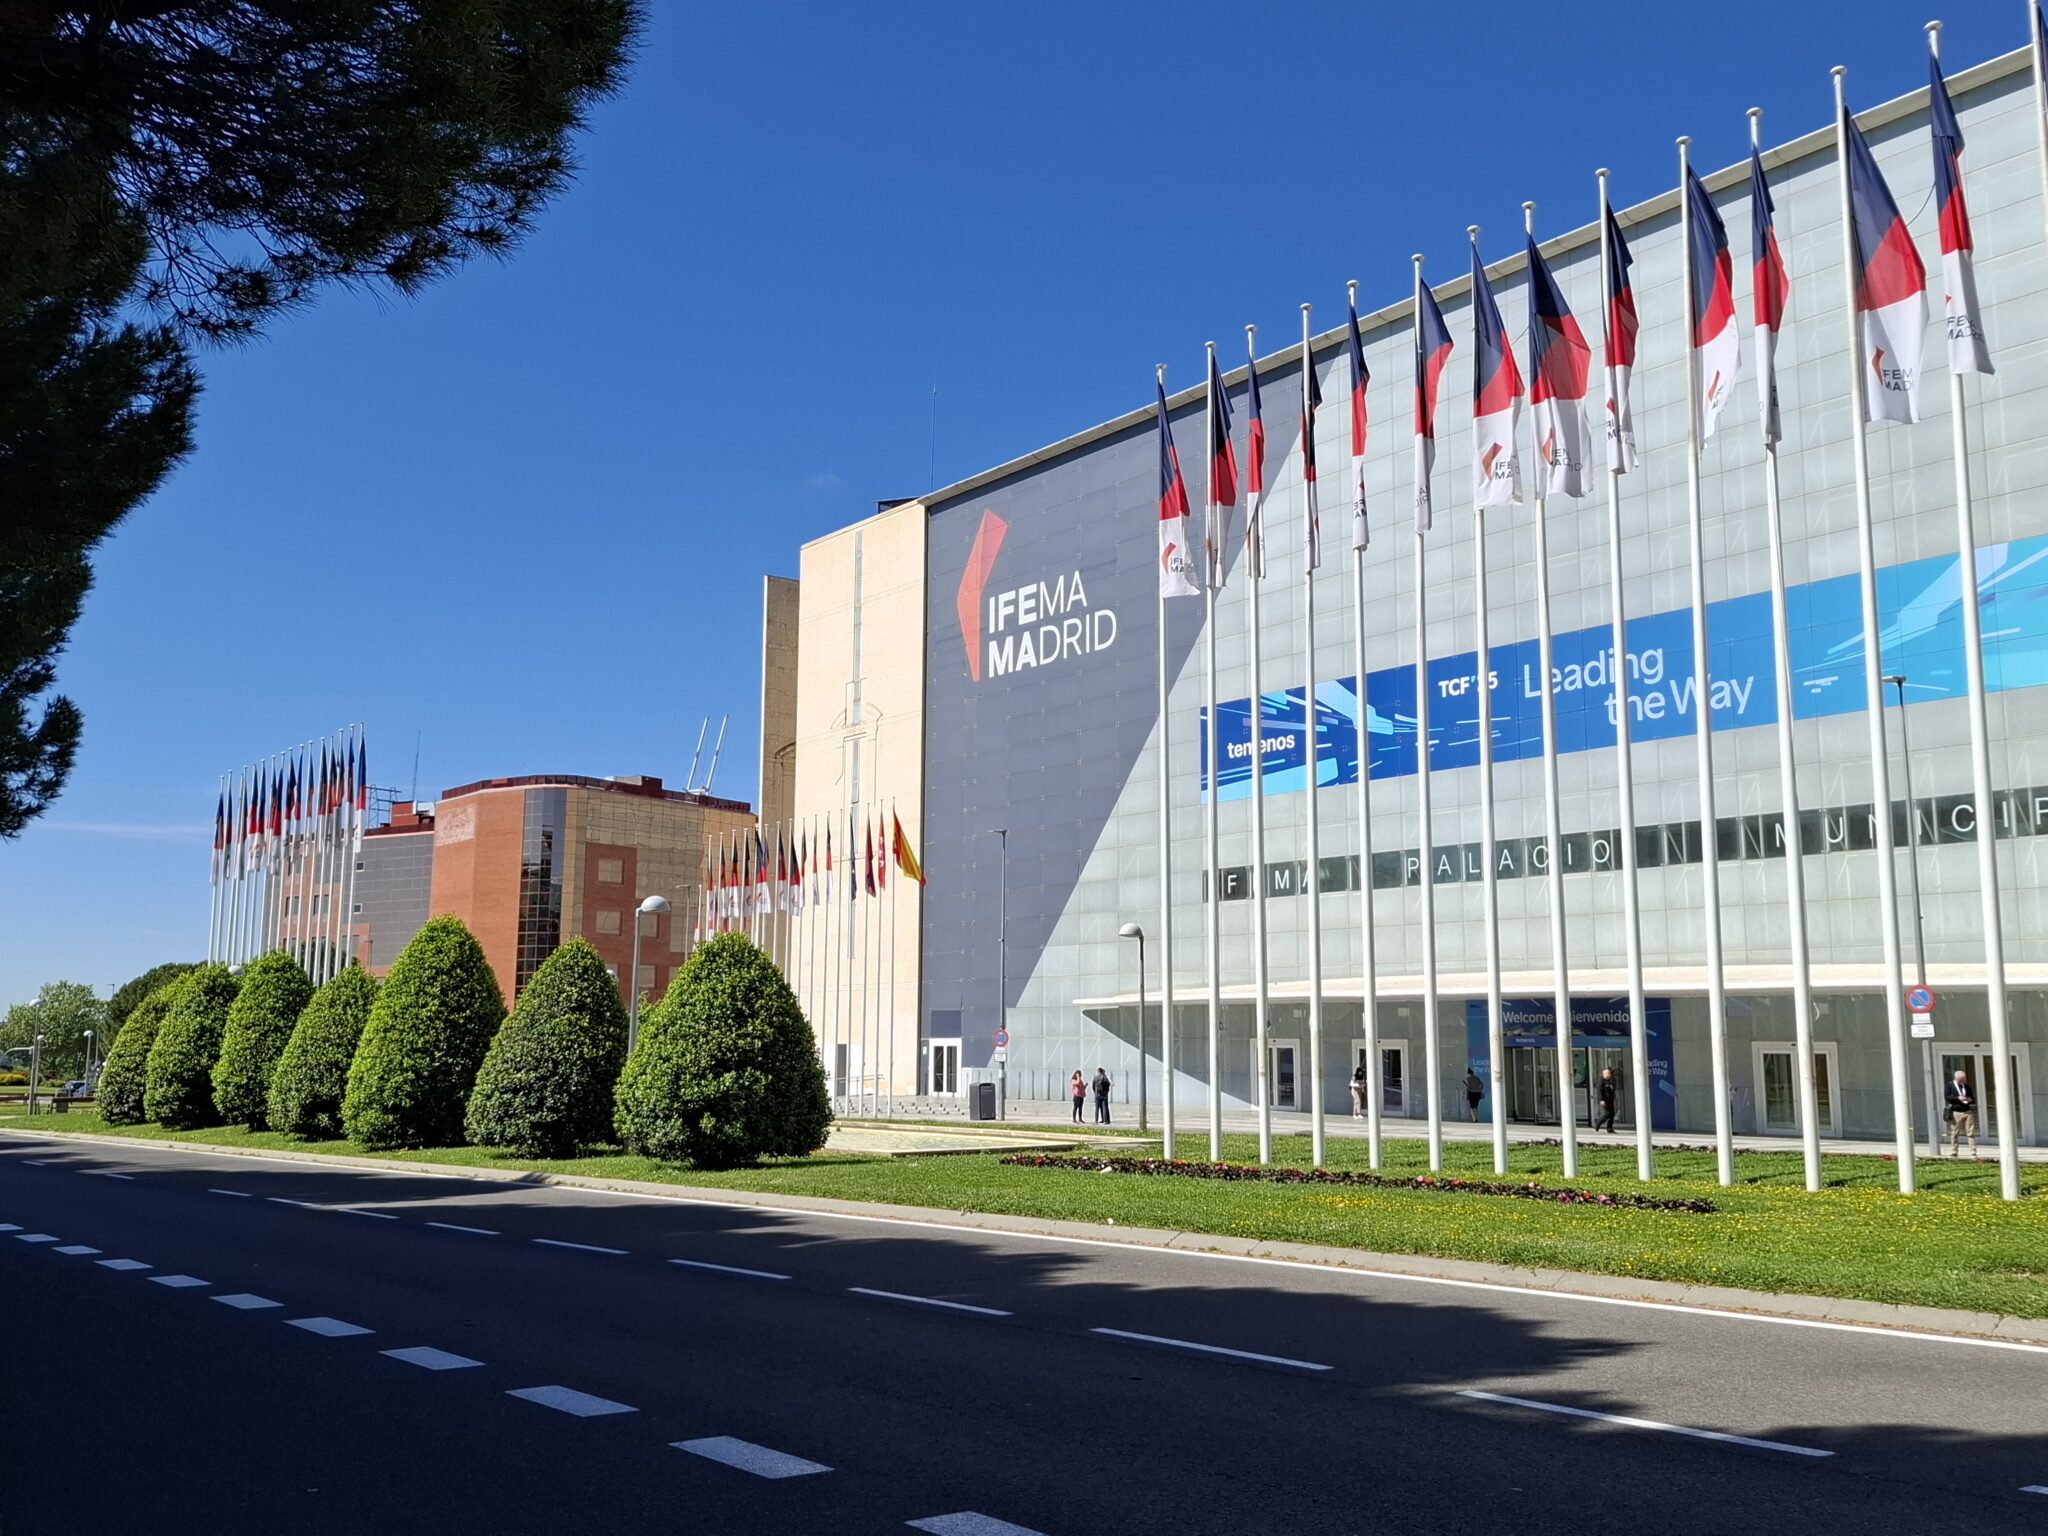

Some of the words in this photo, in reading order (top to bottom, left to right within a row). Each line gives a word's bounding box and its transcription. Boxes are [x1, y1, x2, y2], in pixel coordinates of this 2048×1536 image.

[988, 570, 1087, 634] IFEMA
[988, 609, 1117, 678] MADRID
[1438, 670, 1498, 698] TCF'5
[1523, 647, 1664, 699] Leading
[1669, 673, 1755, 715] Way
[1407, 839, 1610, 879] PALACIO
[1502, 1011, 1554, 1024] Welcome
[1570, 1010, 1630, 1023] ienvenido
